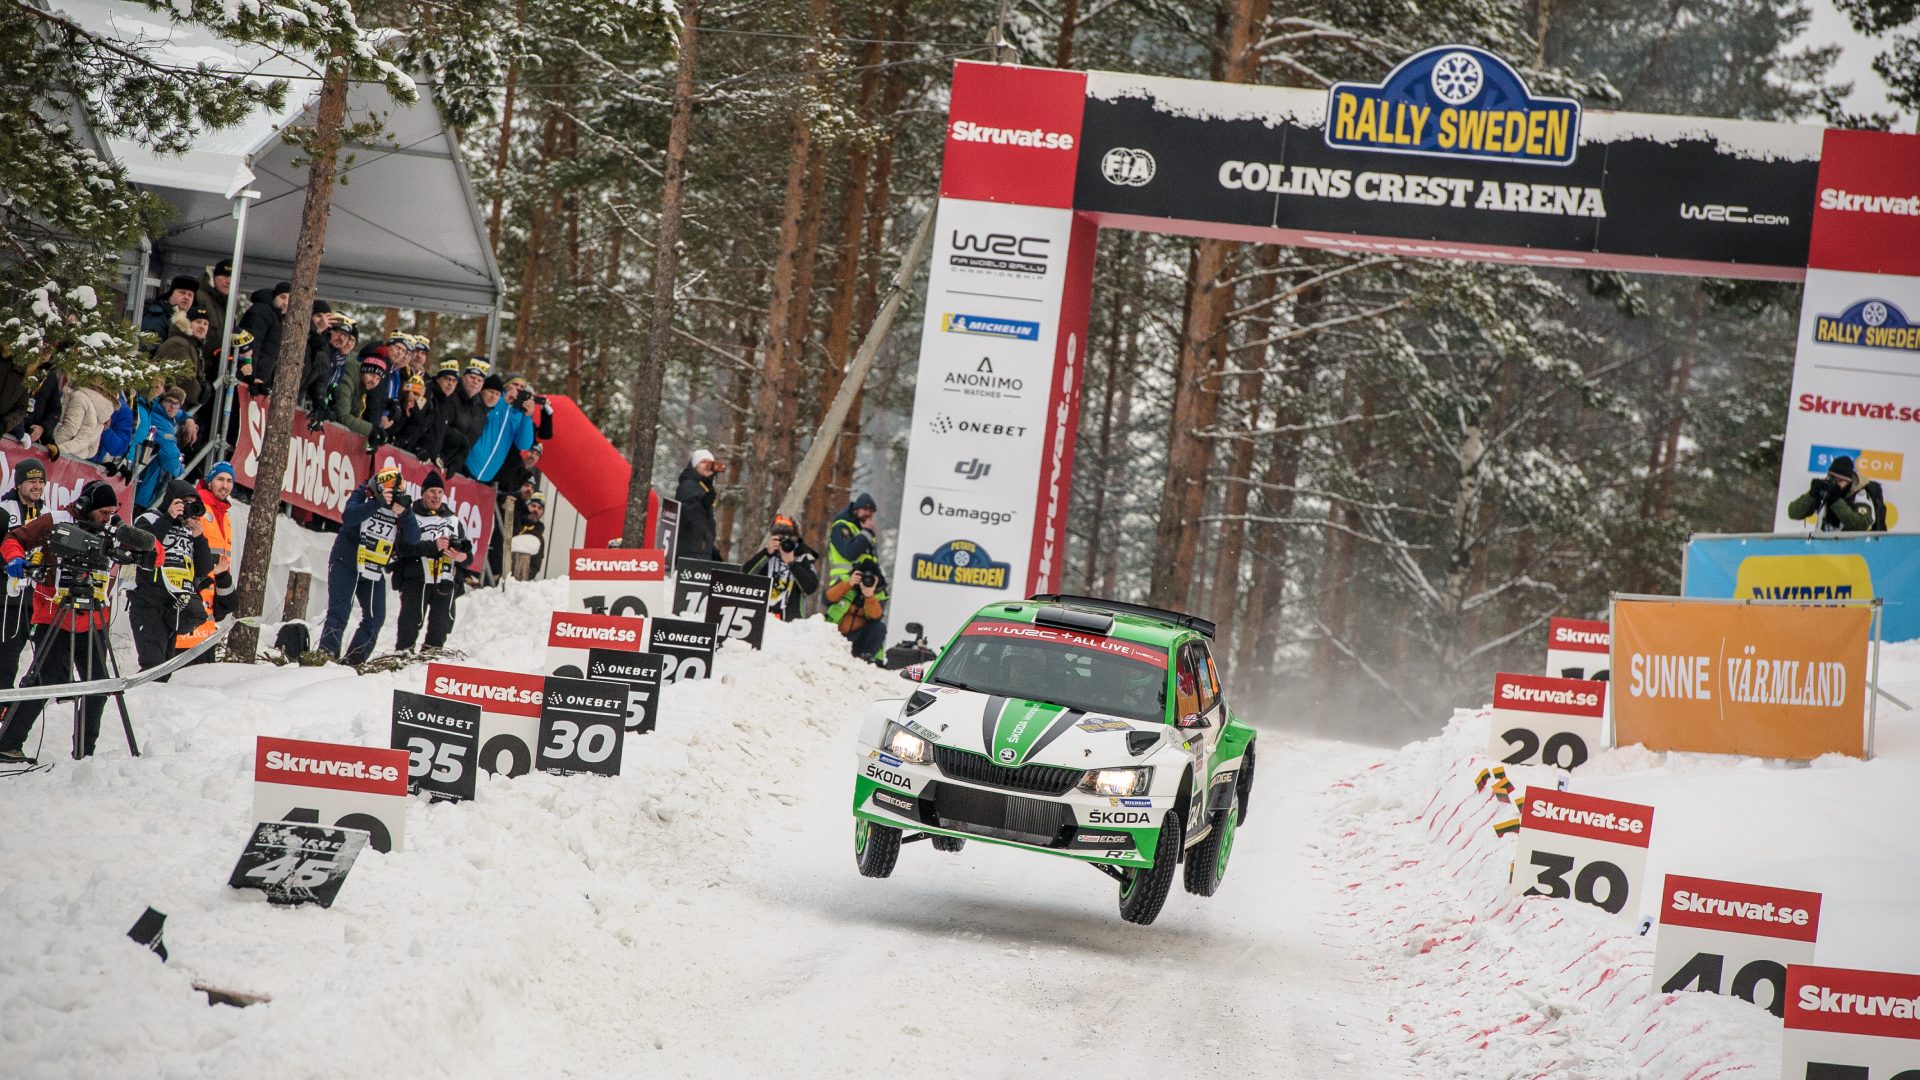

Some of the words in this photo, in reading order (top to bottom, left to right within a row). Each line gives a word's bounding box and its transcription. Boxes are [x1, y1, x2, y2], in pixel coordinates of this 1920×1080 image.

[952, 121, 1073, 150] Skruvat.se
[1335, 92, 1431, 145] RALLY
[1437, 108, 1570, 157] SWEDEN
[1218, 160, 1353, 198] COLINS
[1354, 171, 1474, 208] CREST
[1475, 181, 1607, 218] ARENA
[952, 229, 1050, 259] WRC
[968, 322, 1033, 336] MICHELIN
[1818, 318, 1864, 345] RALLY
[944, 372, 1023, 391] ANONIMO
[959, 421, 1027, 437] ONEBET
[366, 518, 394, 537] 237
[575, 557, 659, 572] Skruvat.se
[917, 559, 953, 581] RALLY
[954, 566, 1005, 588] SWEDEN
[726, 585, 766, 597] ONEBET
[555, 621, 636, 643] Skruvat.se
[718, 606, 756, 639] 15
[668, 633, 711, 645] ONEBET
[1003, 627, 1058, 640] WRC
[1073, 636, 1098, 647] ALL
[1101, 641, 1129, 654] LIVE
[608, 664, 657, 677] ONEBET
[1629, 653, 1710, 700] SUNNE
[1727, 645, 1846, 707] VÄRMLAND
[434, 676, 543, 705] Skruvat.se
[566, 695, 622, 710] ONEBET
[1501, 684, 1598, 707] Skruvat.se
[417, 711, 474, 731] ONEBET
[542, 720, 617, 763] 30
[1500, 728, 1588, 772] 20
[266, 750, 399, 782] Skruvat.se
[408, 737, 467, 783] 35
[866, 763, 912, 790] ŠKODA
[891, 797, 914, 810] EDGE
[1088, 809, 1151, 824] ŠKODA
[1531, 799, 1644, 834] Skruvat.se
[1100, 835, 1127, 843] EDGE
[1105, 850, 1138, 859] R5
[245, 855, 337, 889] 45
[1523, 850, 1629, 915] 30
[1671, 890, 1809, 926] Skruvat.se
